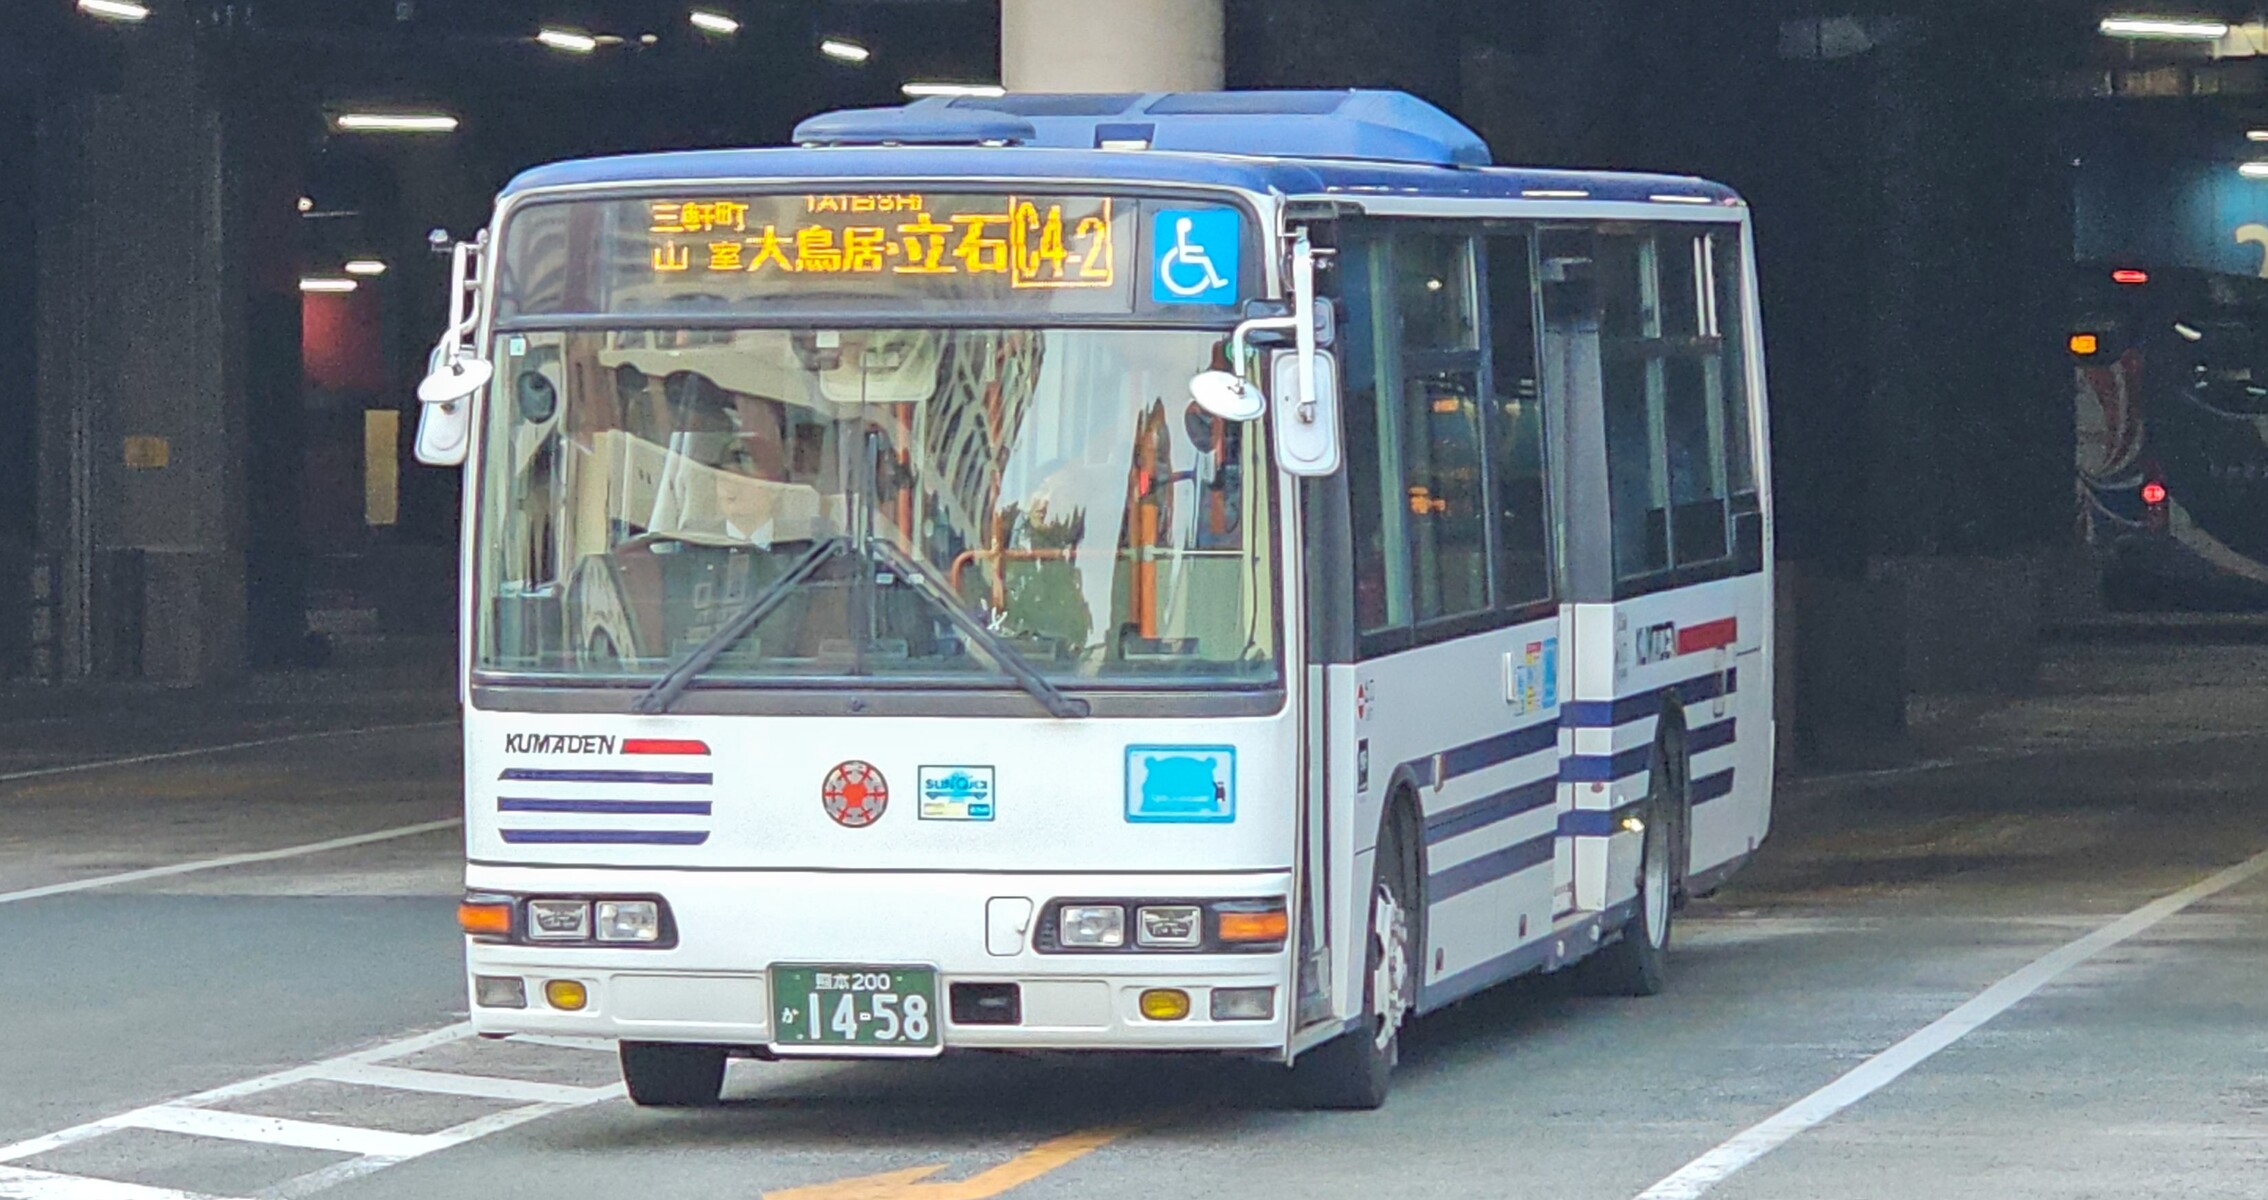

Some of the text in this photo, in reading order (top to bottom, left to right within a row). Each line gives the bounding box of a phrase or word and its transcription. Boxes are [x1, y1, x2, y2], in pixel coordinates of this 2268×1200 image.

[650, 201, 750, 233] 三軒町
[1016, 201, 1106, 278] C4-2
[505, 733, 616, 755] KUMADEN
[808, 992, 929, 1041] 14-58
